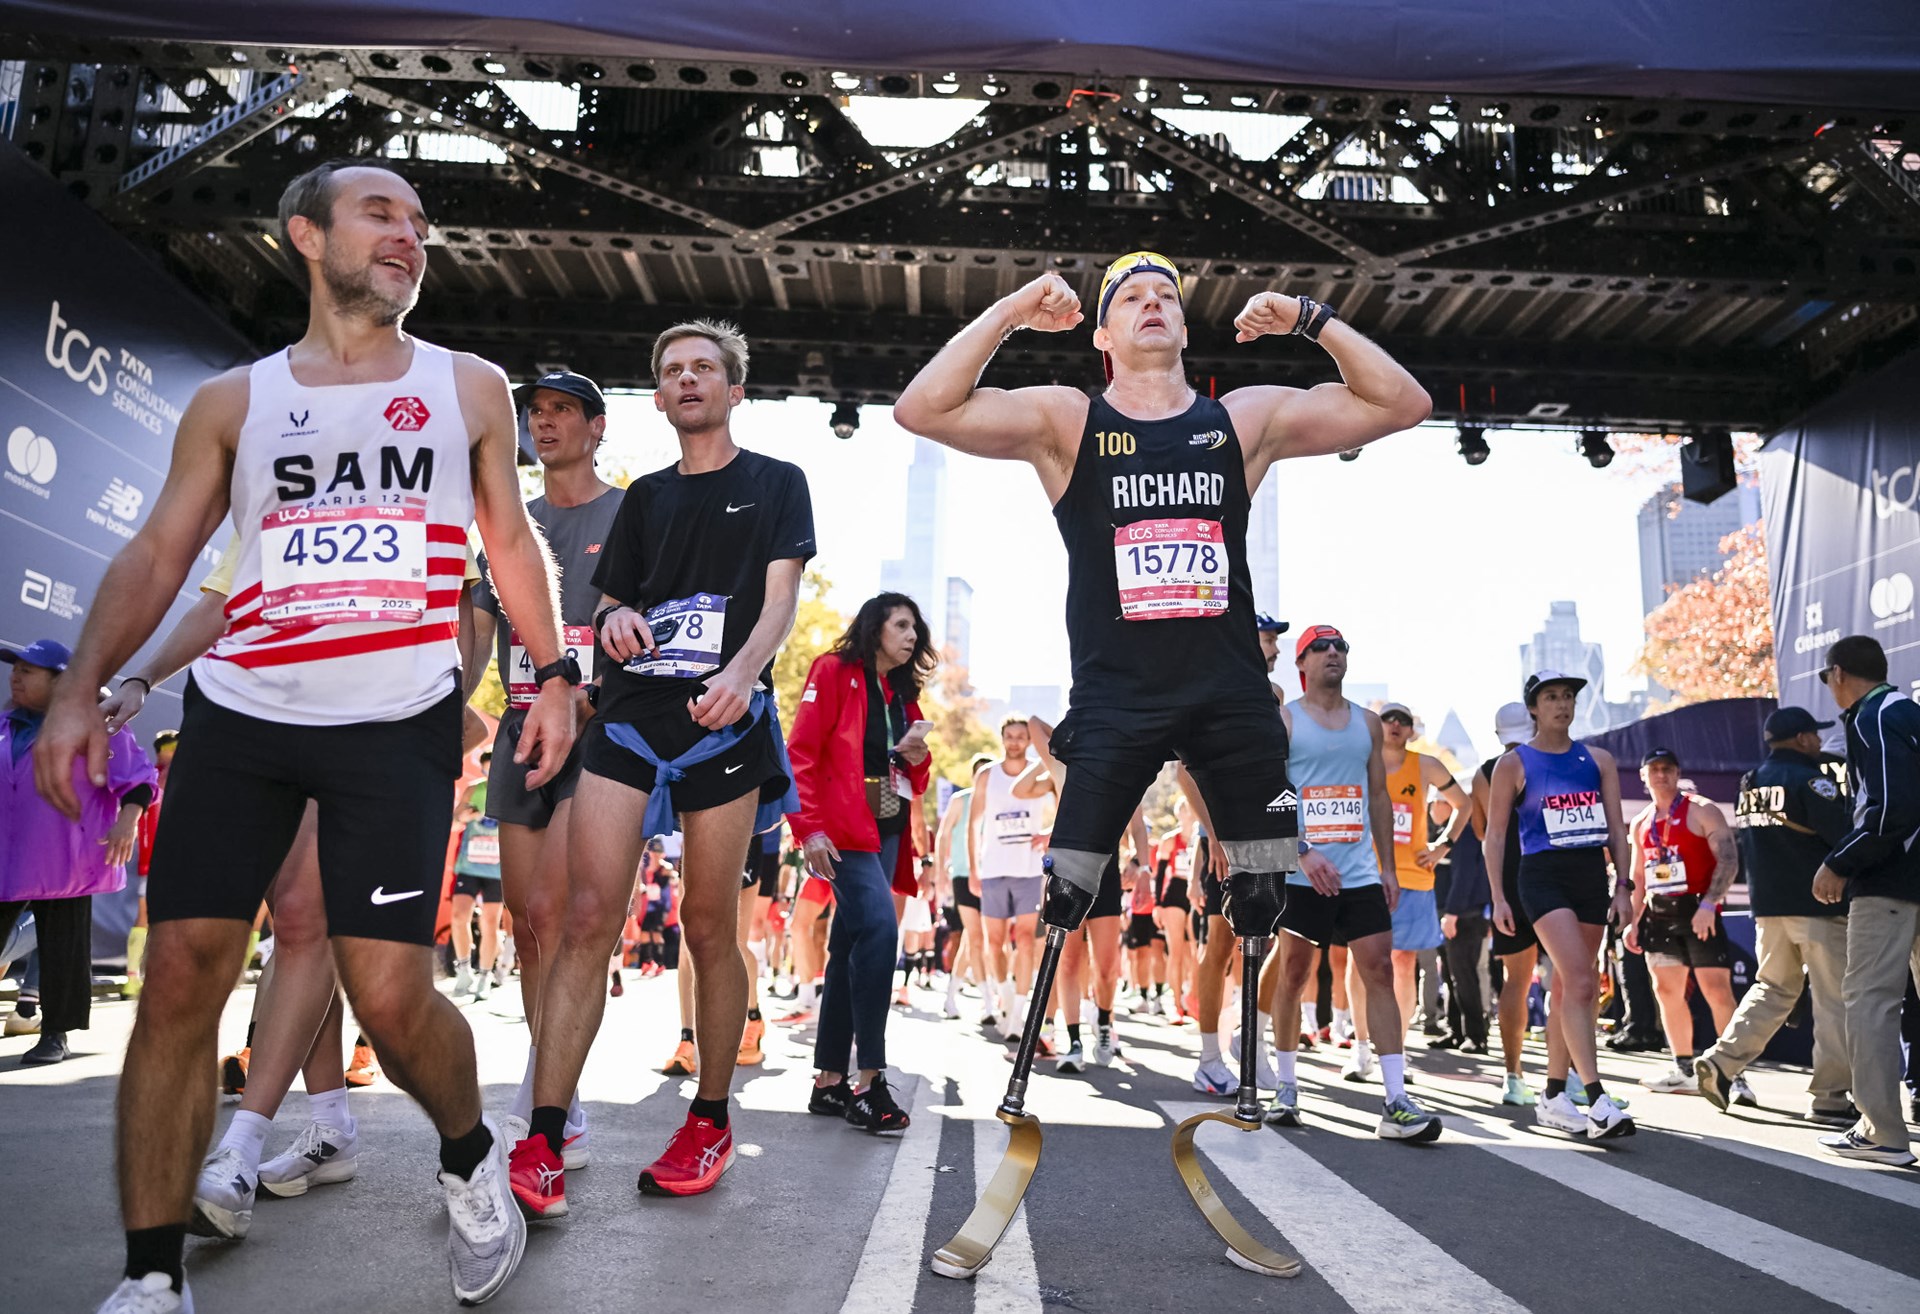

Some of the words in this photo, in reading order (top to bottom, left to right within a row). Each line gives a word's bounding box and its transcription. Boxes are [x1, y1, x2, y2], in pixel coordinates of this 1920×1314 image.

[46, 300, 111, 396] tcs
[120, 347, 153, 386] TATA
[112, 390, 163, 435] SERVICES
[1095, 431, 1137, 456] 100
[273, 446, 434, 502] SAM
[4, 470, 51, 500] mastercard
[1112, 472, 1225, 509] RICHARD
[306, 494, 367, 510] PARIS
[382, 494, 401, 504] 12
[376, 507, 405, 517] TATA
[85, 507, 107, 527] new
[313, 510, 346, 519] SERVICES
[1129, 526, 1153, 540] tcs
[283, 523, 400, 567] 4523
[1127, 543, 1219, 576] 15778
[1199, 588, 1211, 596] VIP
[284, 606, 290, 615] 1
[348, 598, 358, 608] A
[381, 599, 413, 609] 2025
[1203, 600, 1222, 608] 2025
[1306, 802, 1327, 816] AG
[1330, 800, 1361, 816] 2146
[1547, 792, 1595, 809] EMILY
[1555, 805, 1595, 825] 7514
